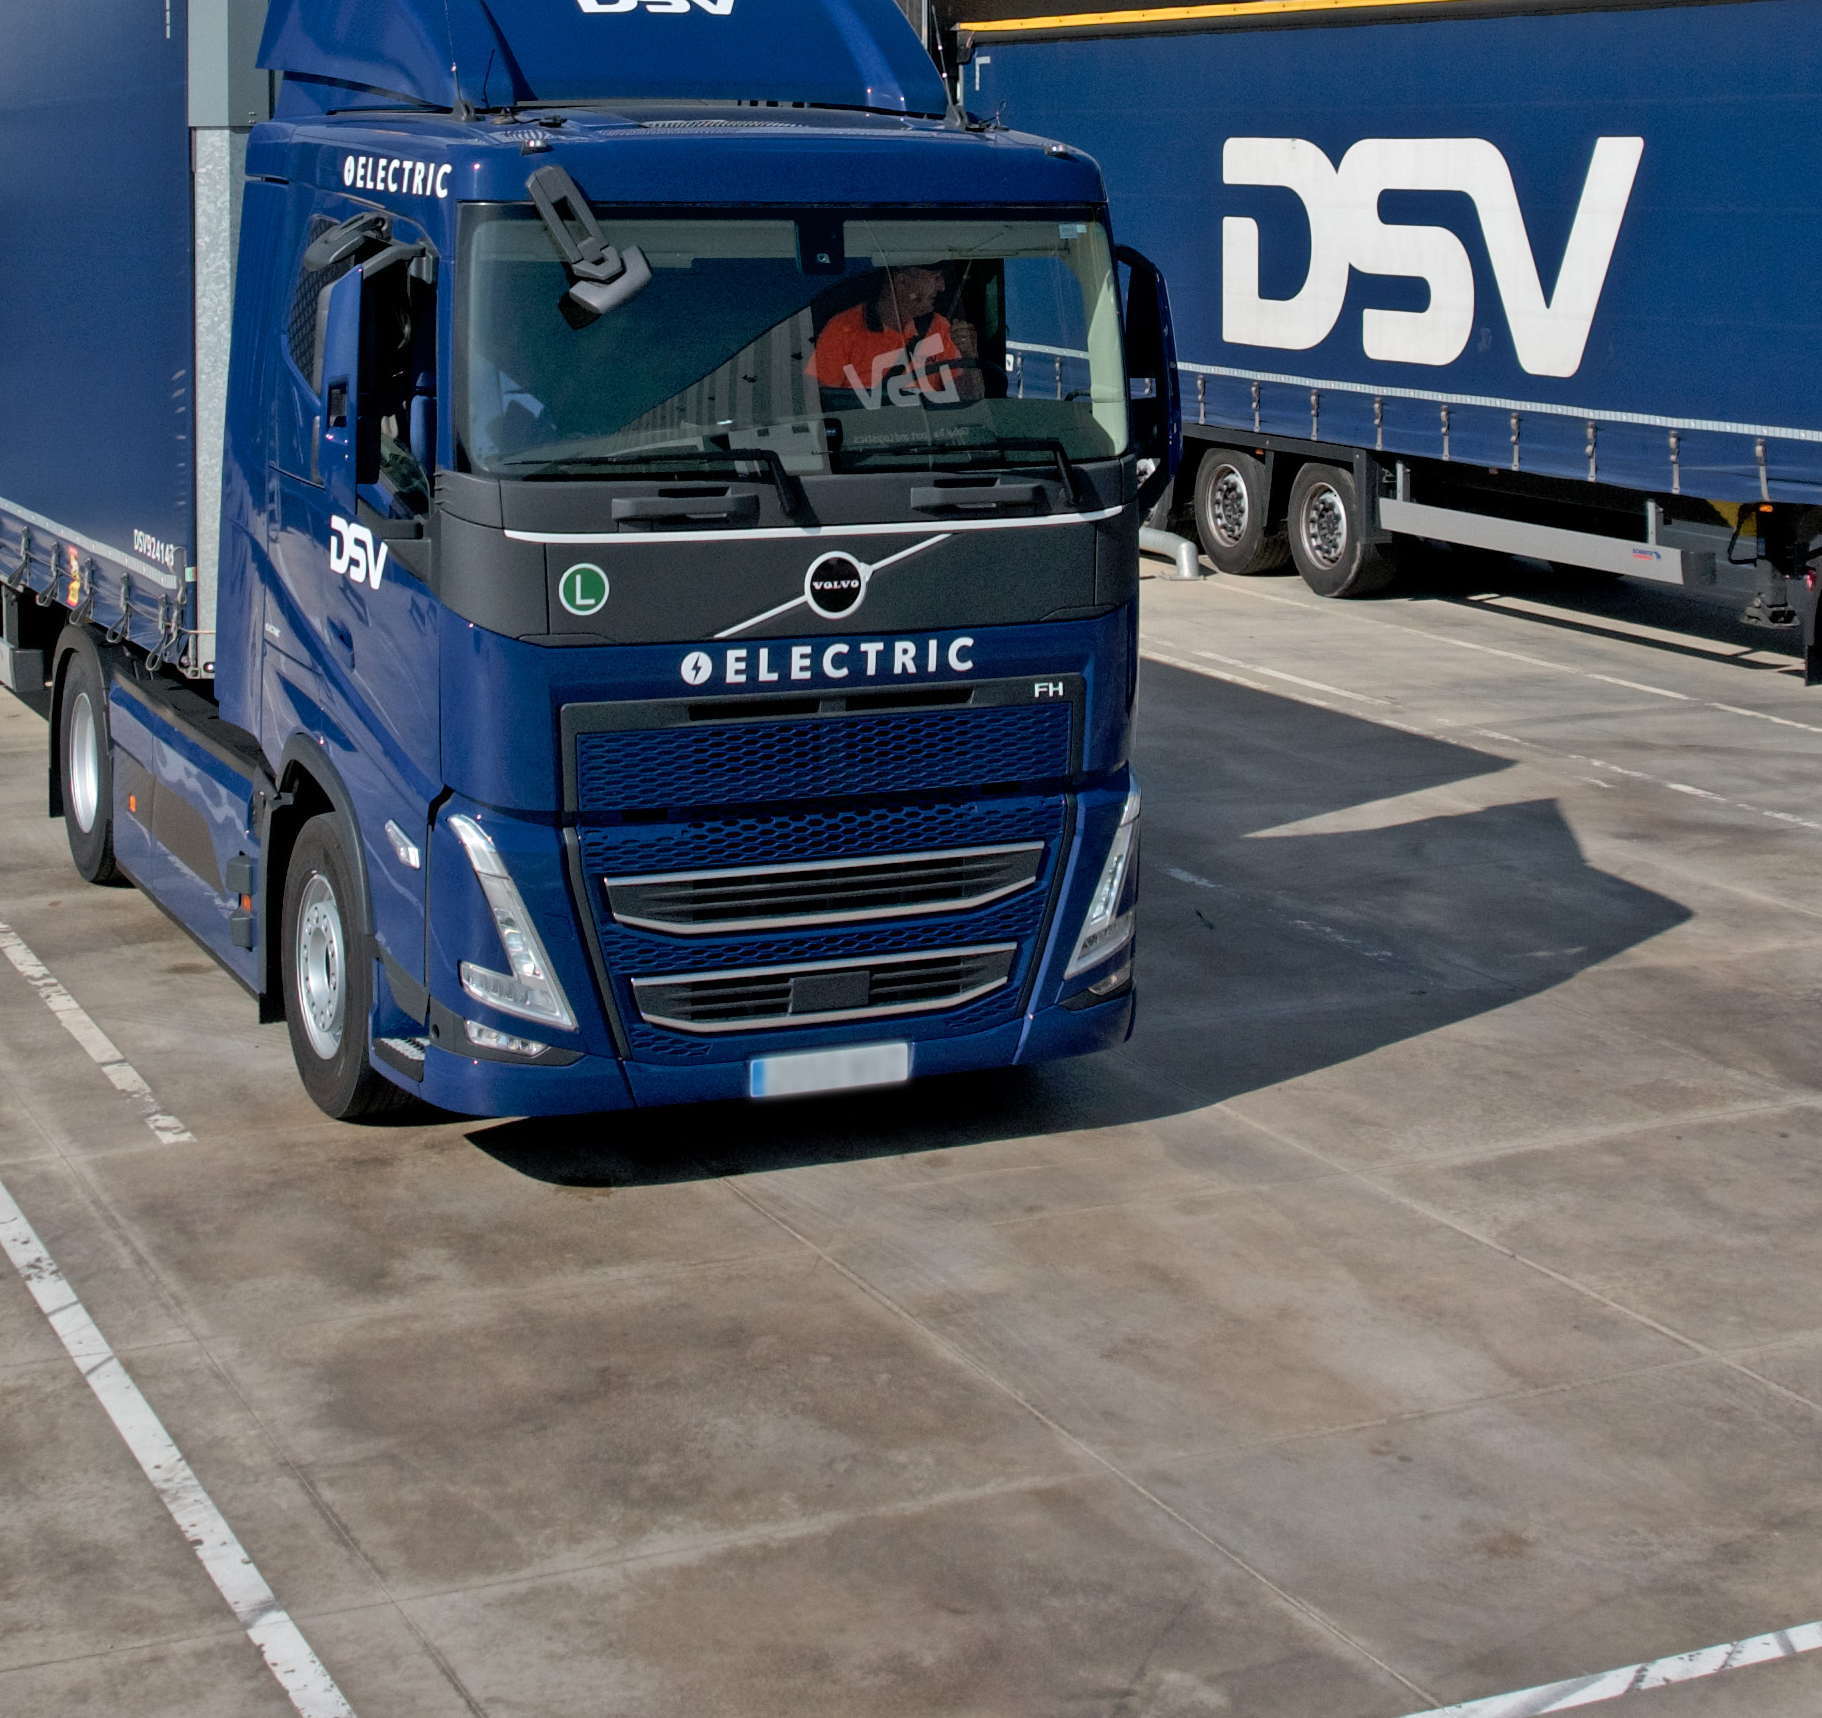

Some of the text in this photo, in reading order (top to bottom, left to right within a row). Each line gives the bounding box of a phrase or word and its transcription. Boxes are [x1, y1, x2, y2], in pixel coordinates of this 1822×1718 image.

[356, 156, 452, 199] ELECTRIC
[1222, 136, 1644, 378] DSV
[330, 514, 389, 590] DSV
[575, 574, 596, 605] L
[812, 579, 860, 590] VOLVO
[725, 636, 975, 684] ELECTRIC
[1034, 682, 1064, 698] FH
